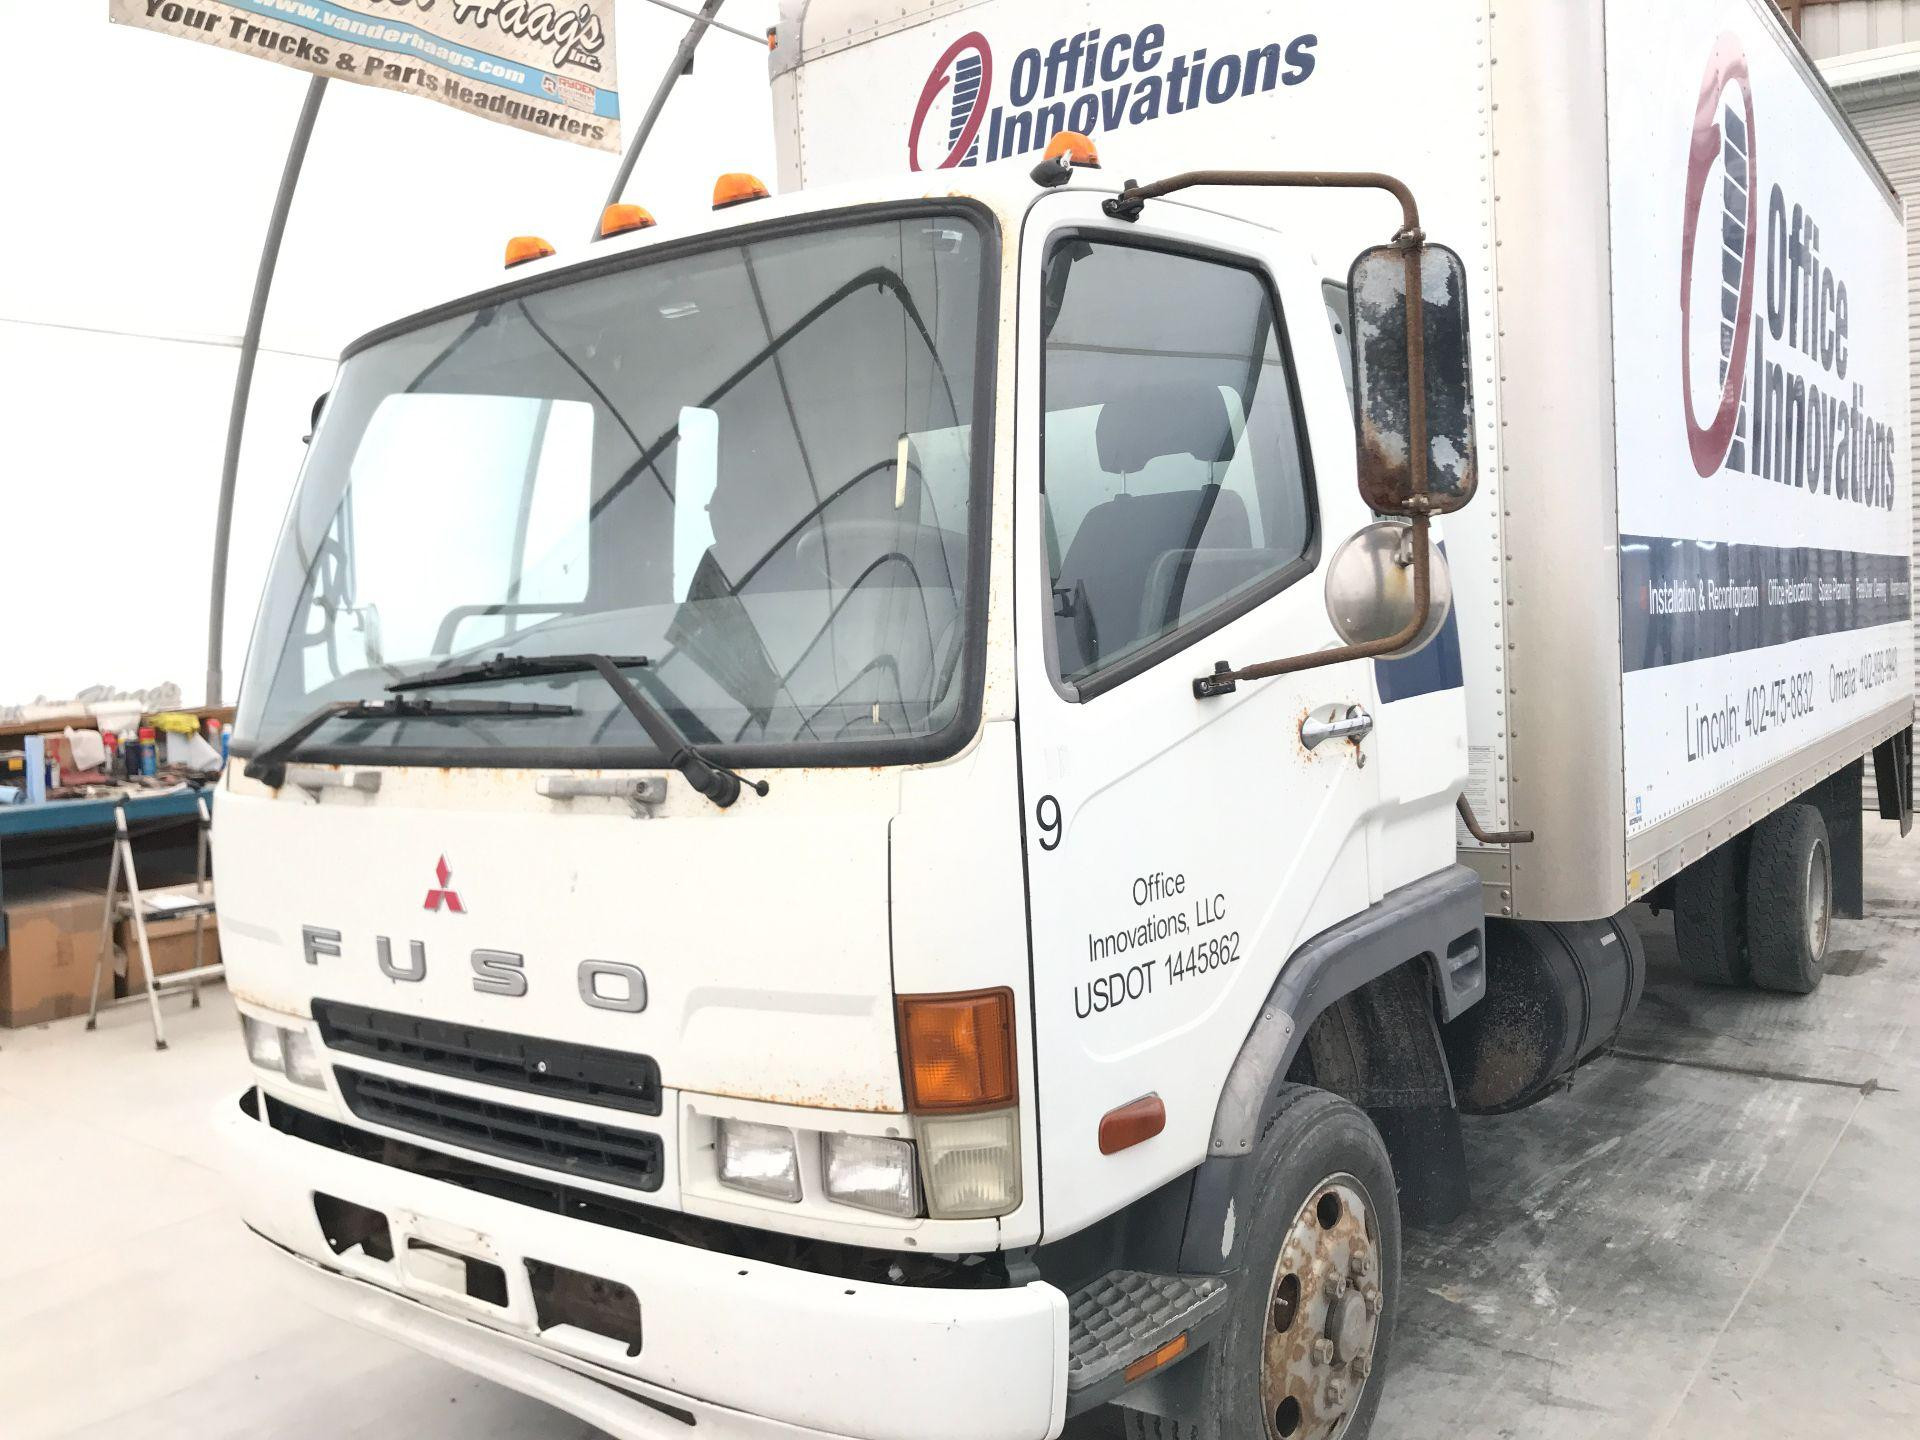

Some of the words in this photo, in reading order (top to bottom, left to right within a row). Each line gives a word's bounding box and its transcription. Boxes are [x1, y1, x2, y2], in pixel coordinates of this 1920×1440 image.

[145, 0, 222, 32] Your
[229, 15, 330, 65] Trucks
[335, 52, 356, 72] &
[364, 56, 438, 92] Parts
[444, 78, 604, 141] Headquarters
[567, 48, 600, 72] Inc.
[986, 33, 1318, 163] Innovations
[1010, 23, 1165, 107] Office
[1767, 183, 1848, 380] Office
[1752, 313, 1895, 511] Innovations
[1649, 580, 1696, 615] Installation
[1699, 581, 1706, 611] &
[1708, 579, 1759, 616] Reconfiguration
[1686, 694, 1740, 763] Lincoln:
[1745, 670, 1814, 737] 402-475-8832
[1036, 795, 1062, 851] 9
[1089, 911, 1190, 962] Innovations,
[1196, 893, 1226, 927] LLC
[1132, 872, 1185, 906] Office
[302, 924, 648, 1014] FUSO
[1074, 960, 1156, 1019] USDOT
[1165, 931, 1240, 985] 1445862
